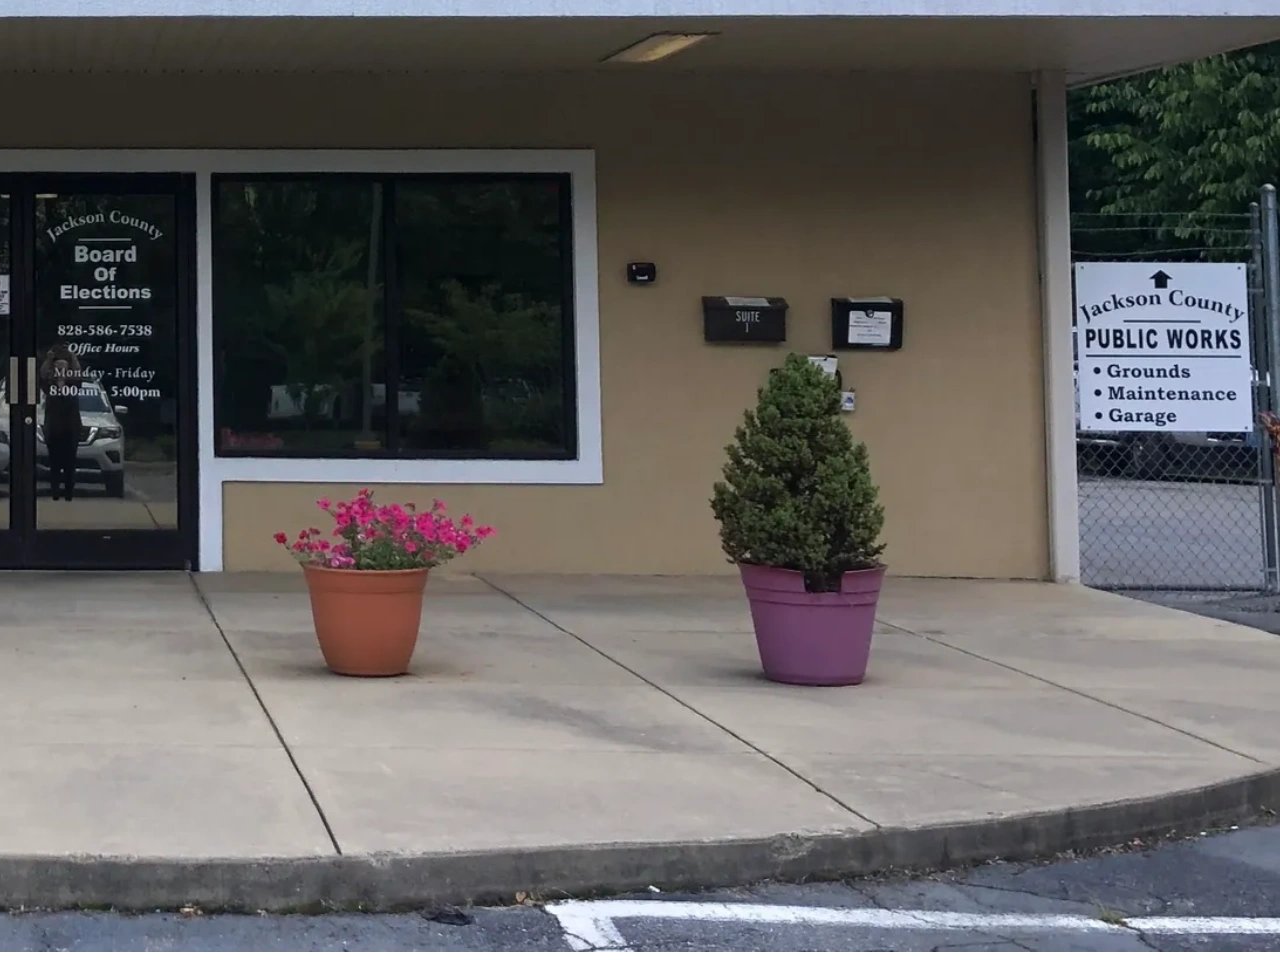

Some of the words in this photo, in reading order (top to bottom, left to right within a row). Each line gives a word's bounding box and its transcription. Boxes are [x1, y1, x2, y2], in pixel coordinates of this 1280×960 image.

[46, 212, 105, 243] Jackson
[109, 209, 163, 240] County
[74, 244, 137, 263] Board
[93, 266, 117, 282] Of
[60, 284, 152, 300] Elections
[1079, 293, 1162, 325] Jackson
[1168, 289, 1246, 324] County
[735, 310, 761, 323] SUITE
[57, 324, 153, 336] 828-586-7538
[745, 322, 749, 333] 1
[1085, 328, 1159, 350] PUBLIC
[1166, 328, 1242, 350] WORKS
[67, 342, 102, 356] Office
[104, 343, 140, 353] Hours
[53, 366, 105, 381] Monday
[114, 366, 156, 383] Friday
[1106, 363, 1191, 379] Grounds
[49, 384, 98, 397] 8:00am
[111, 385, 161, 401] 5:00pm
[1107, 386, 1238, 401] Maintenance
[1108, 408, 1177, 426] Garage
